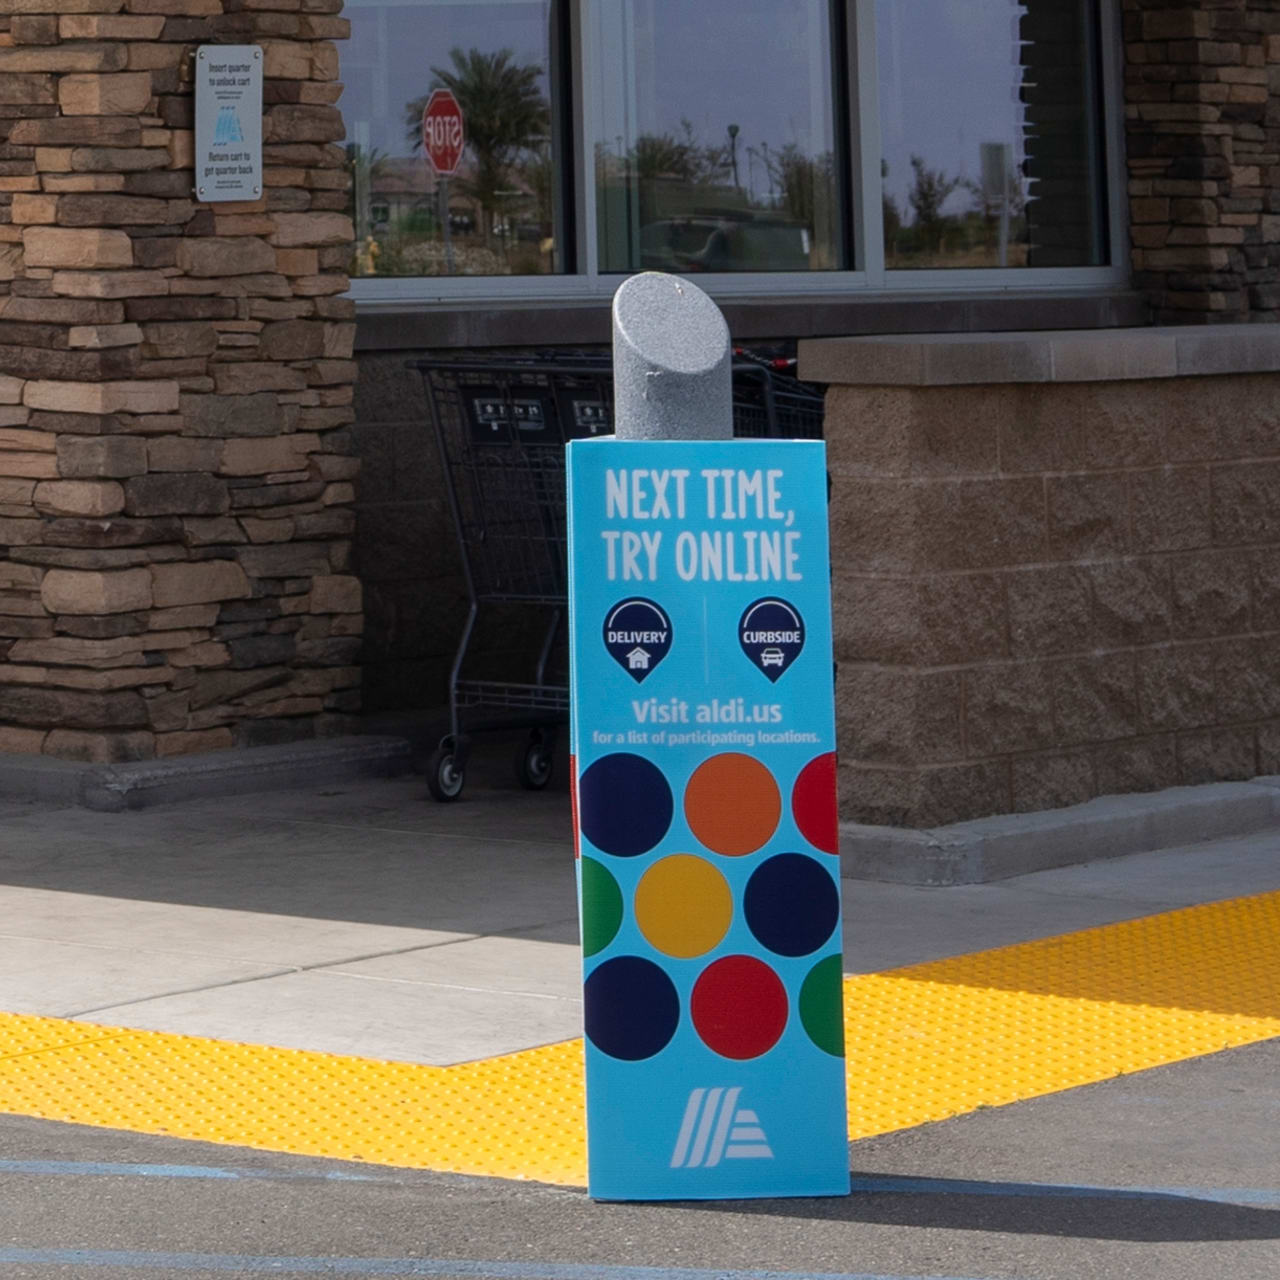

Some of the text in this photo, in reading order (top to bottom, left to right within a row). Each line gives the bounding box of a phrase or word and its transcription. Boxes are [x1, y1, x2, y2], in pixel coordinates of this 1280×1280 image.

[605, 468, 795, 527] NEXT TIME,
[601, 531, 803, 582] TRY ONLINE
[607, 630, 668, 644] DELIVERY
[743, 630, 801, 644] CURBSIDE
[631, 698, 782, 724] Visit aldi.us
[592, 730, 821, 746] for a list of participating locations.
